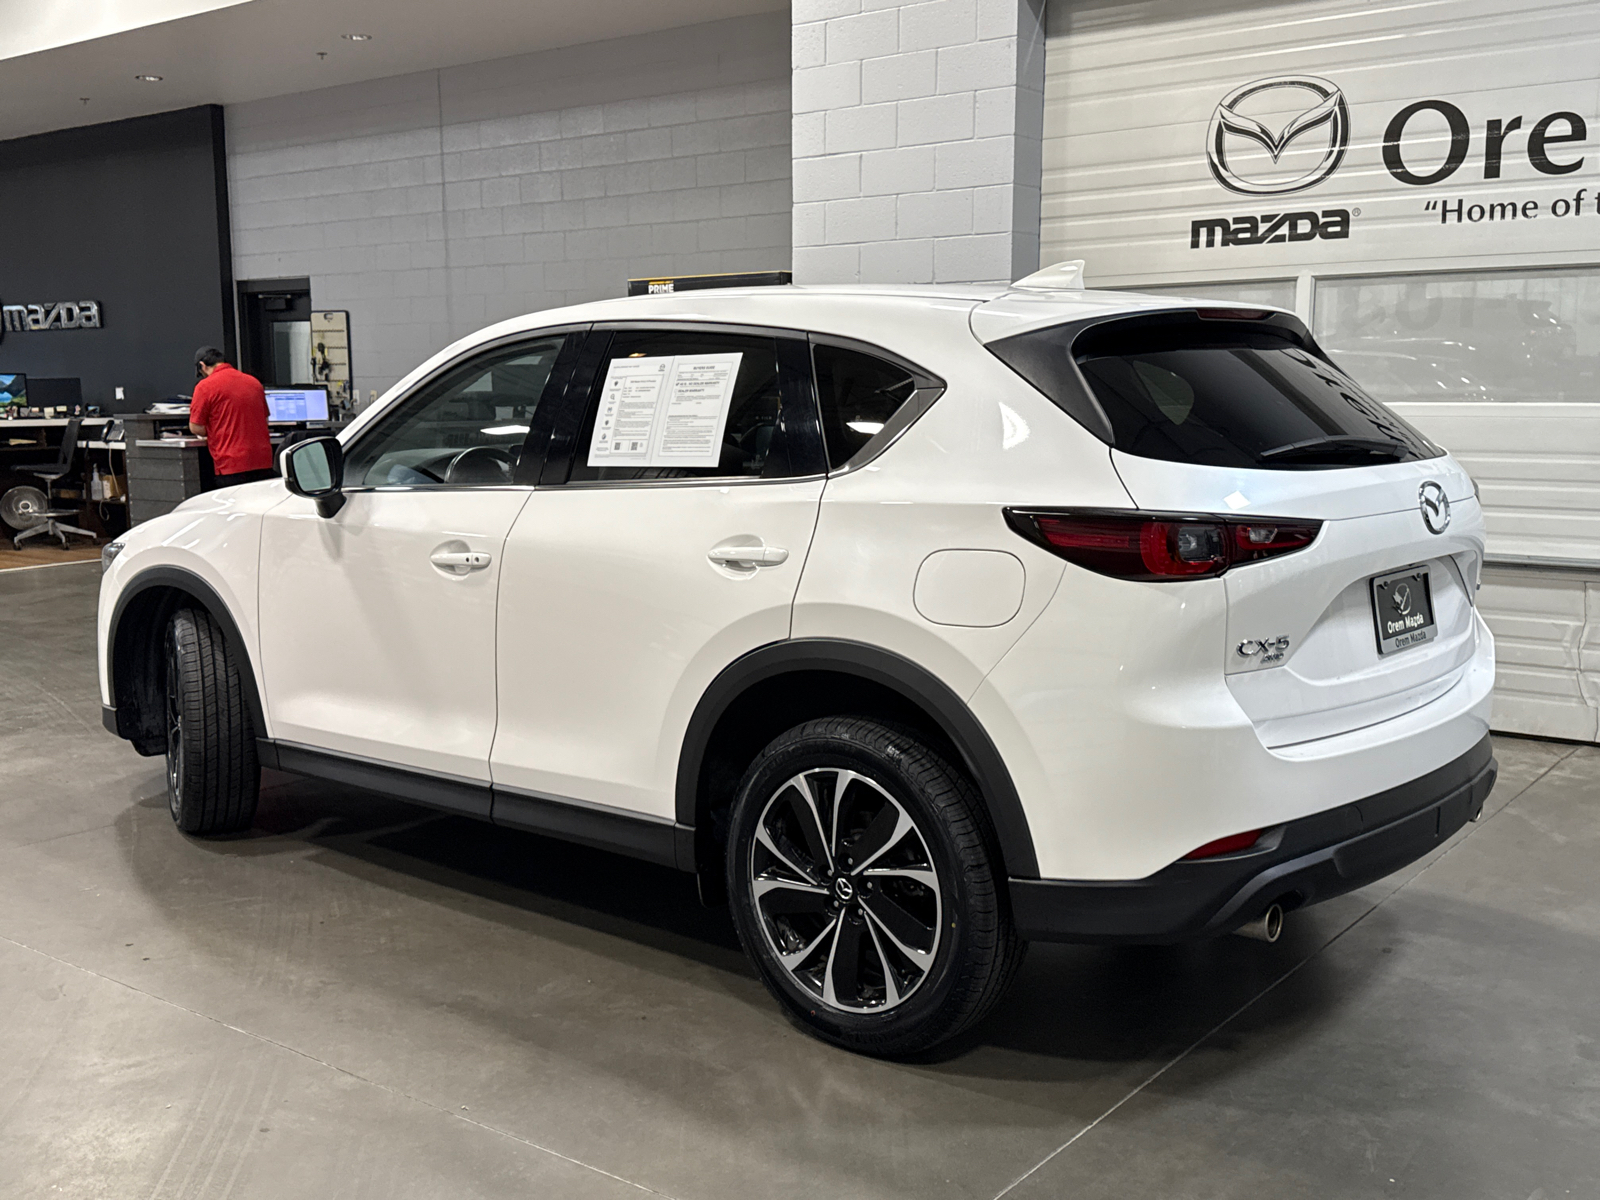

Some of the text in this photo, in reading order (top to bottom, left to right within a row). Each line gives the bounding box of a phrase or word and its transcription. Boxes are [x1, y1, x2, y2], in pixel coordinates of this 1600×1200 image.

[1382, 99, 1587, 186] Ore
[1551, 188, 1587, 218] of
[1190, 208, 1350, 249] mazda
[648, 283, 674, 294] PRIME
[2, 301, 100, 331] mazda
[1387, 612, 1424, 634] Orem Mazda
[1236, 634, 1290, 658] CX-5
[1395, 630, 1427, 648] Orem Mazda
